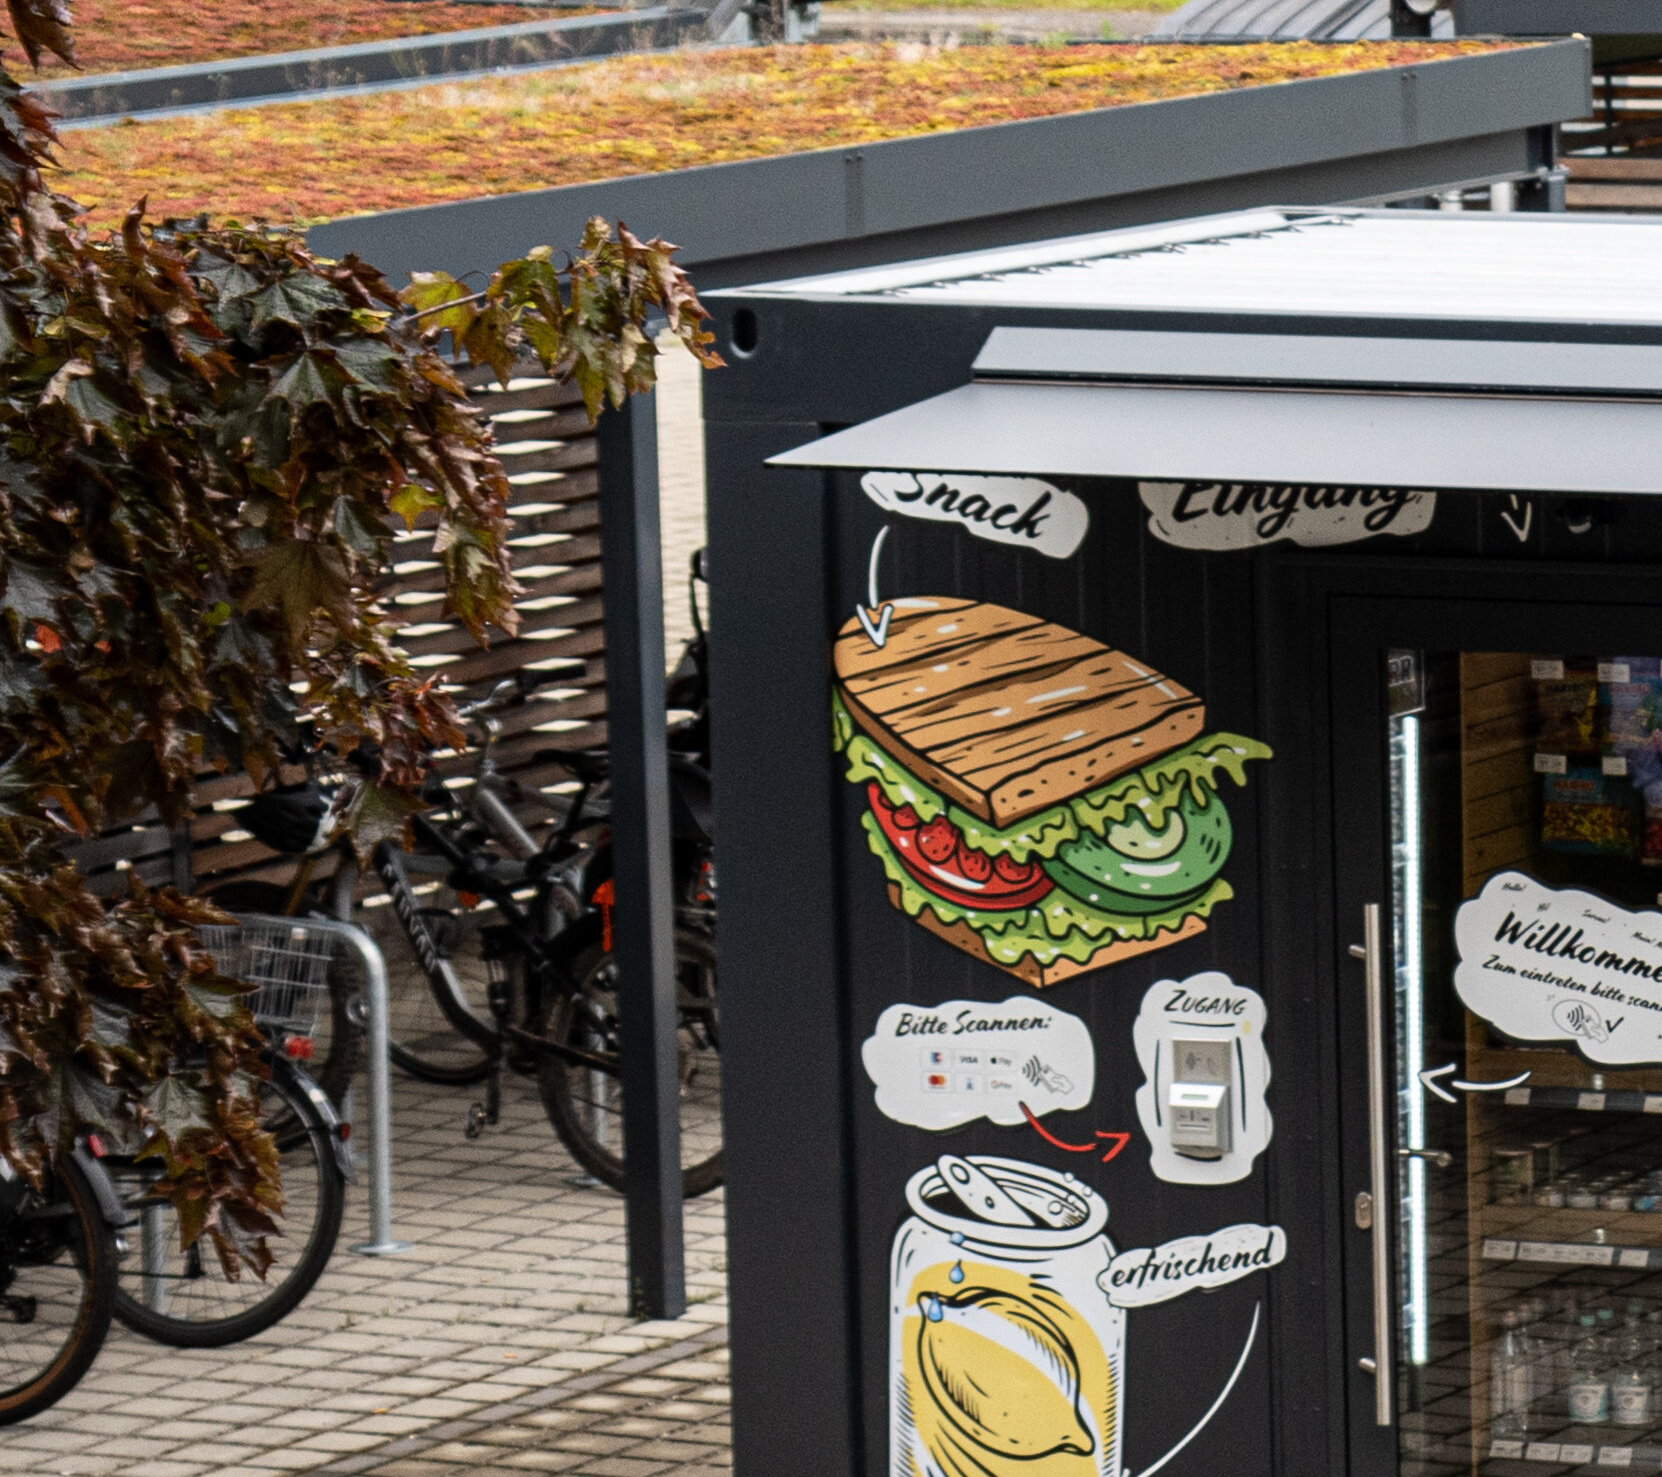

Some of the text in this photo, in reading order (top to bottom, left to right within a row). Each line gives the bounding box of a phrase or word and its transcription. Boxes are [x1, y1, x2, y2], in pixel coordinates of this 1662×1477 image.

[1482, 954, 1516, 975] Zum
[1520, 967, 1587, 993] eintreten
[1591, 982, 1625, 1003] bitte
[1165, 989, 1247, 1016] ZUGANG
[896, 1009, 1054, 1037] Bitte Scannen:
[1111, 1230, 1273, 1290] erfrischend
